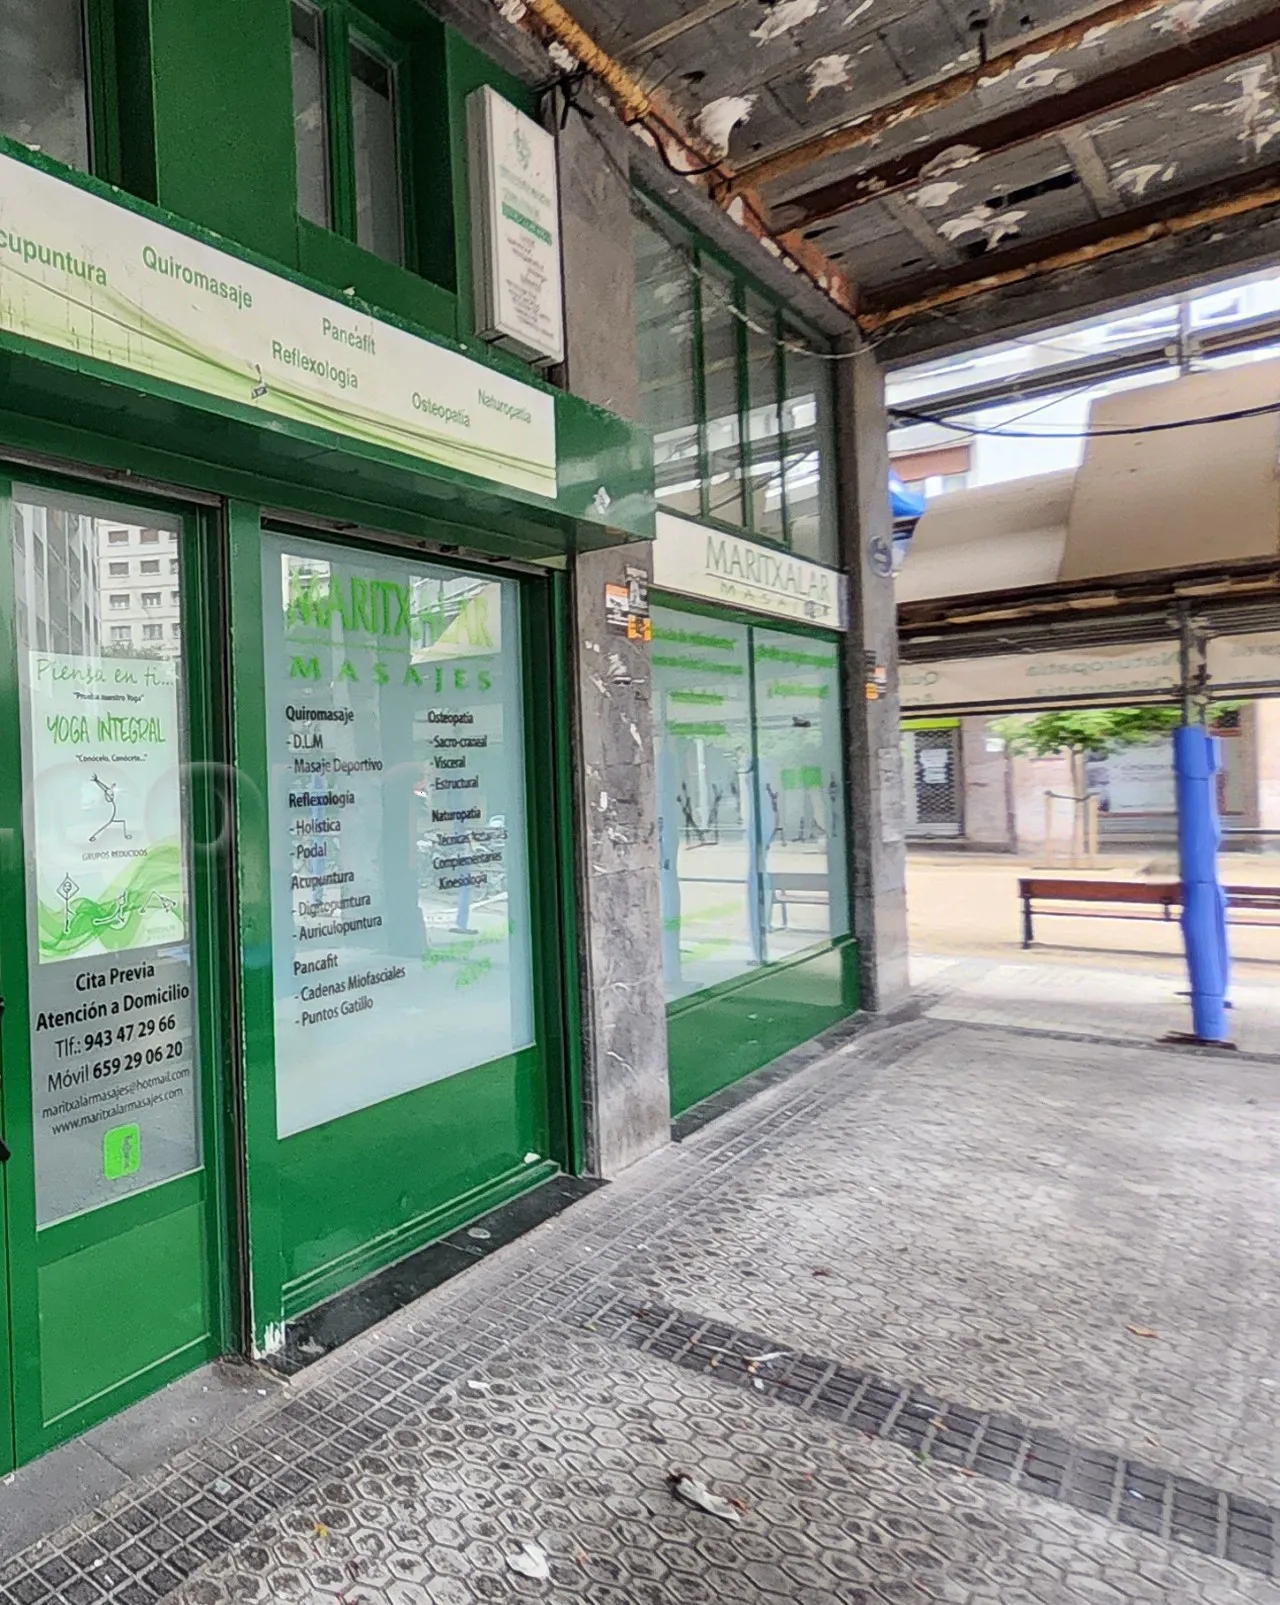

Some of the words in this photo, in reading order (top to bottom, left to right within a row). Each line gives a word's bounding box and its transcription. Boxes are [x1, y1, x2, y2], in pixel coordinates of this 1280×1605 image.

[142, 245, 253, 310] Quiromasaje
[322, 316, 376, 355] Pancafit
[705, 535, 831, 602] MARITXALAR
[286, 566, 494, 649] MARITXALAR
[36, 658, 107, 685] Piensa
[114, 668, 138, 684] en
[290, 655, 493, 694] MASAJES
[47, 714, 91, 745] YOGA
[97, 711, 167, 744] INTEGRAL
[286, 705, 355, 725] Quiromasaje
[294, 758, 332, 776] Masaje
[333, 758, 384, 776] Deportivo
[434, 755, 466, 769] Visceral
[435, 774, 479, 791] Estructural
[288, 789, 355, 808] Reflexología
[296, 817, 341, 835] Holística
[82, 850, 110, 861] GRUPOS
[111, 848, 148, 859] REDUCIDOS
[296, 841, 327, 859] Podal
[290, 871, 355, 891] Acupuntura
[298, 894, 372, 918] Digitopuntura
[299, 915, 383, 941] Auriculopuntura
[76, 971, 106, 992] Cita
[110, 962, 155, 986] Previa
[293, 953, 339, 976] Pancafit
[300, 982, 347, 1002] Cadenas
[347, 966, 406, 991] Miofasciales
[36, 1001, 108, 1032] Atención
[111, 1002, 120, 1015] a
[123, 984, 190, 1012] Domicilio
[301, 1006, 340, 1027] Puntos
[340, 995, 374, 1016] Gatillo
[55, 1039, 81, 1058] Tlf.:
[84, 1029, 113, 1052] 943
[116, 1024, 135, 1044] 47
[138, 1019, 155, 1039] 29
[158, 1014, 176, 1033] 66
[47, 1064, 90, 1093] Móvil
[93, 1057, 121, 1080] 659
[124, 1052, 143, 1072] 29
[145, 1046, 164, 1066] 06
[166, 1040, 183, 1060] 20
[42, 1067, 190, 1119] maritxalarmasajes@hotmail.com
[52, 1087, 184, 1135] www.maritxalarmasajes.com
